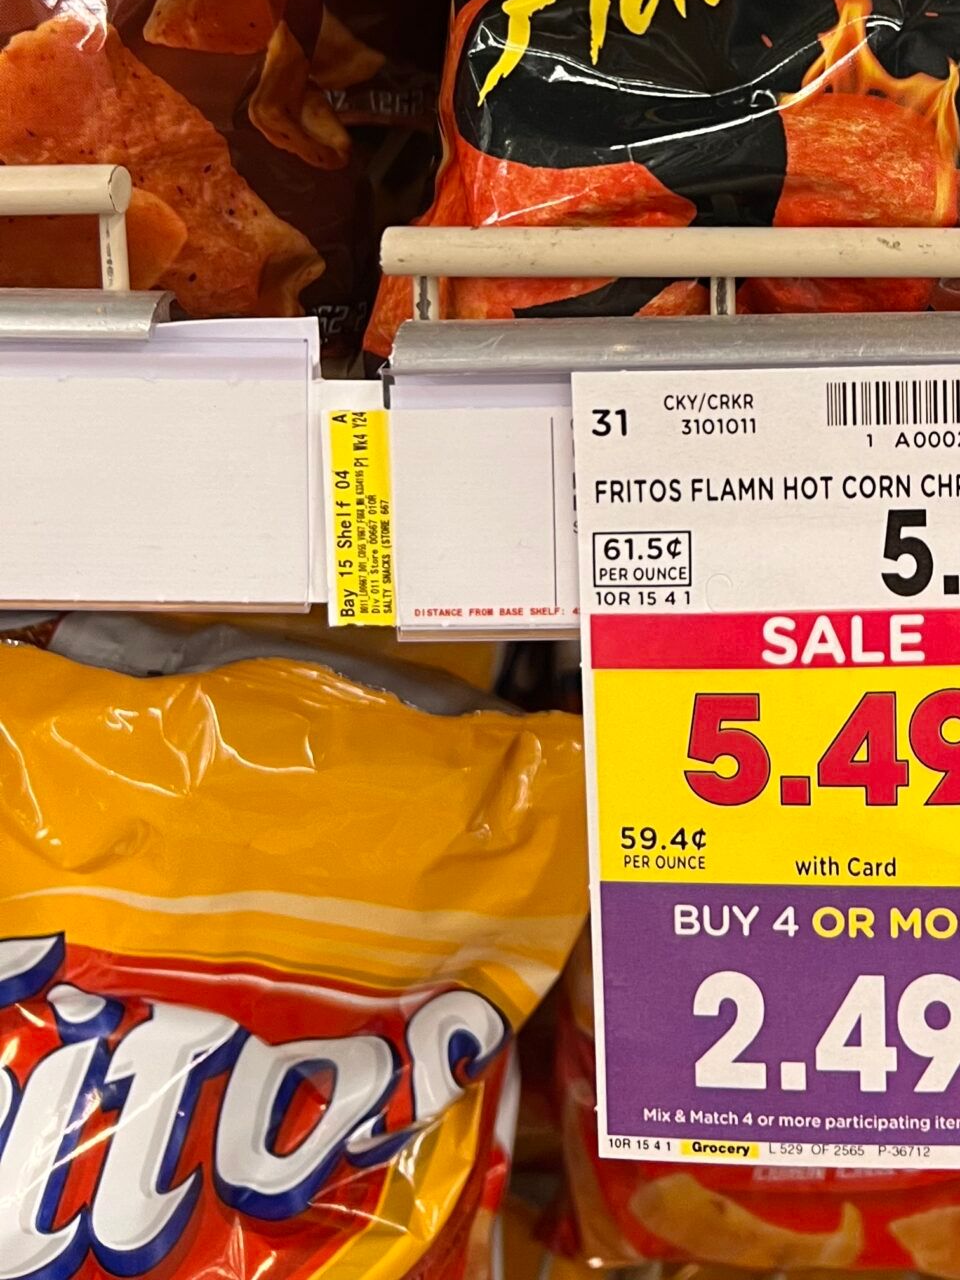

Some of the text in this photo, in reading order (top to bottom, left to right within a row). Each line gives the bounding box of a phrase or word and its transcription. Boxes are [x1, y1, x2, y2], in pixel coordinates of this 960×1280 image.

[664, 393, 754, 412] CKY/CRKR
[352, 411, 367, 429] Y24
[592, 409, 628, 436] 31
[682, 418, 756, 435] 3101011
[866, 434, 873, 447] 1
[595, 479, 681, 503] FRITOS
[691, 477, 773, 501] FLAMN
[784, 476, 833, 500] HOT
[842, 475, 911, 499] CORN
[332, 413, 359, 617] Bay 15 Shelf 04 A
[379, 499, 390, 515] 667
[603, 537, 682, 560] 61.5¢
[370, 549, 379, 575] Store
[382, 553, 391, 584] SNACKS
[599, 567, 687, 581] PER OUNCE
[371, 579, 380, 595] 011
[371, 598, 381, 614] Div
[383, 587, 393, 614] SALTY
[596, 591, 691, 606] 10R 15 4 1
[414, 607, 462, 617] DISTANCE
[469, 607, 494, 616] FROM
[499, 607, 524, 616] BASE
[530, 606, 565, 616] SHELF:
[762, 614, 926, 664] SALE
[621, 827, 707, 851] 59.4¢
[624, 855, 706, 870] PER OUNCE
[795, 856, 896, 877] with Card
[674, 904, 760, 937] BUY
[772, 906, 799, 937] 4
[812, 907, 875, 938] OR
[0, 933, 507, 1278] itos
[643, 1108, 671, 1122] Mix
[675, 1110, 686, 1123] &
[690, 1110, 739, 1125] Match
[742, 1113, 753, 1126] 4
[757, 1116, 774, 1127] or
[779, 1116, 821, 1128] more
[825, 1115, 931, 1132] participating
[608, 1137, 631, 1150] 10R
[637, 1139, 650, 1151] 15
[654, 1140, 662, 1151] 4
[692, 1141, 750, 1157] Grocery
[780, 1144, 803, 1155] 529
[811, 1144, 829, 1155] OF
[834, 1144, 865, 1156] 2565
[878, 1146, 931, 1158] P-36712
